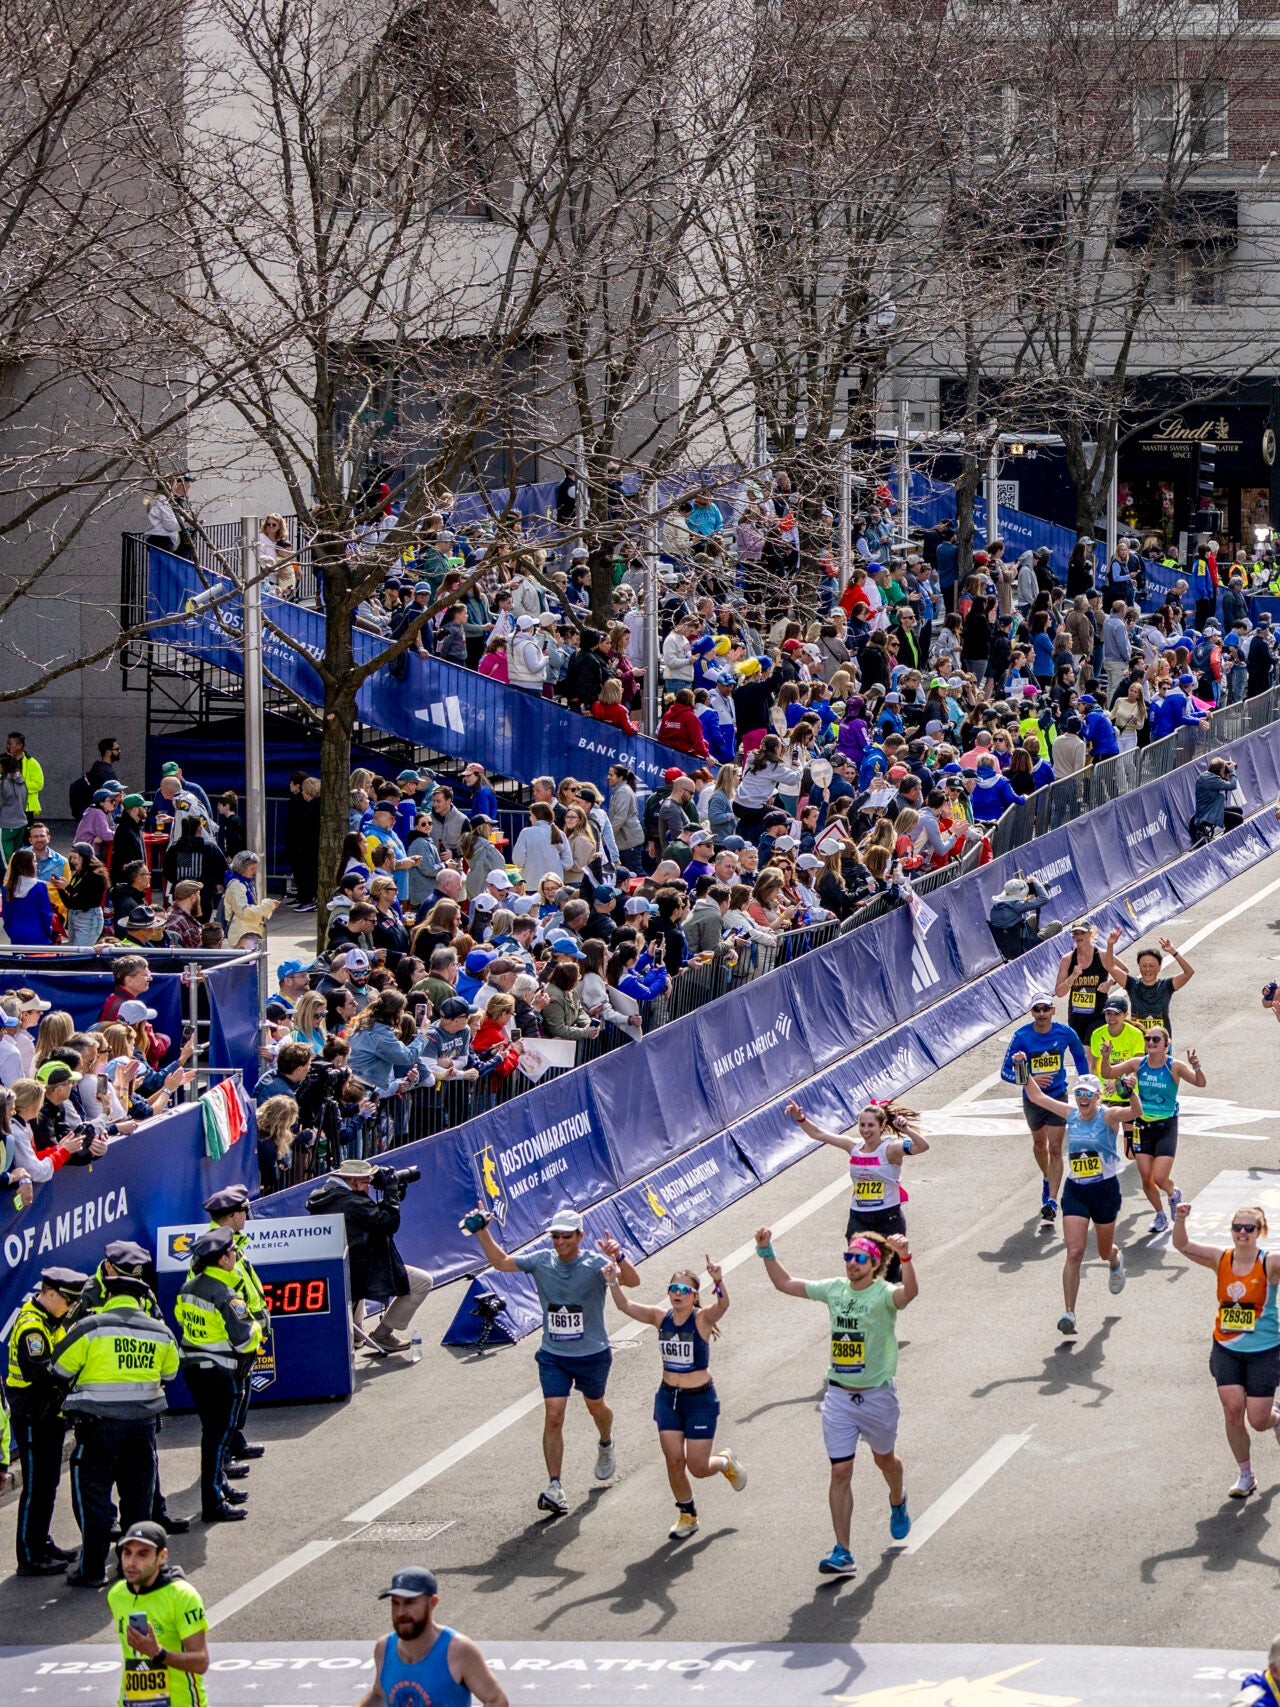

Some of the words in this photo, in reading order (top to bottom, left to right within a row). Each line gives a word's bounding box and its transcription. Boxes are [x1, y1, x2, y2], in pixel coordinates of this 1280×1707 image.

[1152, 418, 1215, 439] Lindt
[1000, 520, 1032, 538] MERICA
[578, 738, 616, 758] BANK
[619, 752, 637, 765] OF
[1072, 992, 1095, 1004] 27520
[713, 1059, 733, 1078] BANK
[734, 1052, 745, 1071] OF
[746, 1030, 778, 1063] AMERICA
[1033, 1056, 1059, 1069] 26864
[500, 1136, 542, 1177] BOSTON
[539, 1109, 592, 1159] MARATHON
[1072, 1159, 1100, 1171] 27182
[509, 1178, 530, 1200] BANK
[541, 1157, 568, 1182] AMERICA
[856, 1182, 882, 1195] 27122
[4, 1226, 38, 1269] OF
[38, 1186, 129, 1255] AMERICA
[260, 1226, 332, 1240] MARATHON
[246, 1241, 290, 1250] AMERICA
[551, 1313, 581, 1328] 16613
[836, 1316, 858, 1330] MIKE
[114, 1339, 156, 1355] BOSTON
[660, 1342, 690, 1358] 16610
[832, 1343, 863, 1358] 29894
[118, 1354, 154, 1370] POLICE
[35, 1660, 122, 1675] 129
[208, 1657, 376, 1673] OSTO
[484, 1657, 756, 1673] ARATHON
[125, 1672, 167, 1691] 30093
